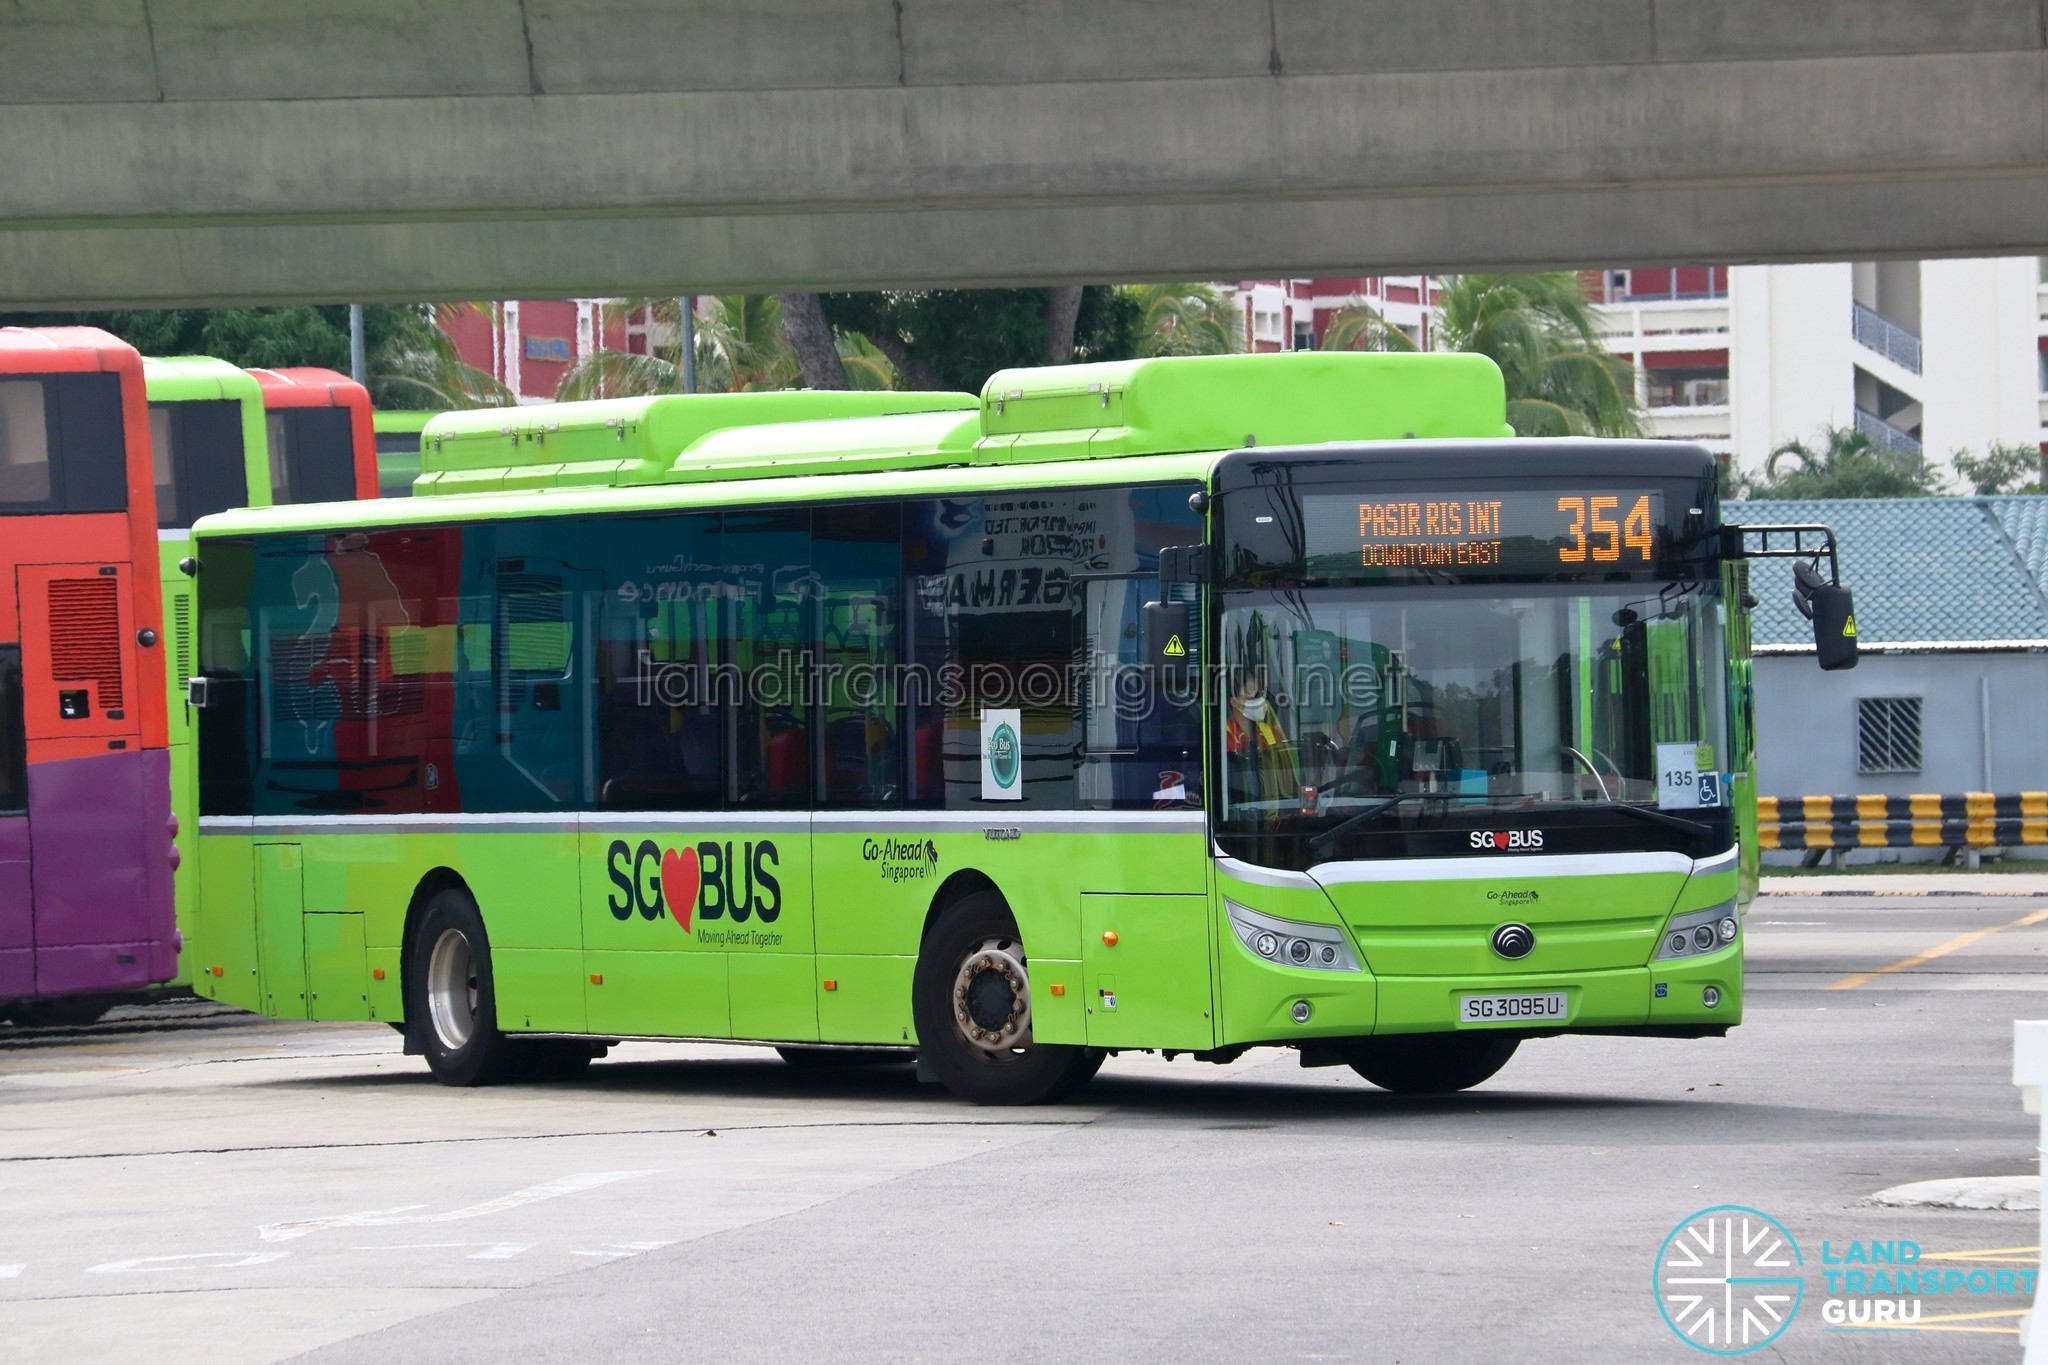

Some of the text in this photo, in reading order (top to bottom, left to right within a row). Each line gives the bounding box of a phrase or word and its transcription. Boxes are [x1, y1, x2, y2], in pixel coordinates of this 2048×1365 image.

[1359, 500, 1502, 537] PASIR RIS INT
[1557, 494, 1652, 563] 354
[1362, 540, 1502, 567] DOWNTOWN EAST
[1665, 770, 1693, 787] 135
[862, 838, 922, 861] Go-Ahead
[880, 861, 925, 884] Singapore
[1486, 890, 1529, 900] Go-Ahead
[697, 928, 784, 950] Moving Ahead Together
[1468, 997, 1560, 1017] SG3095U
